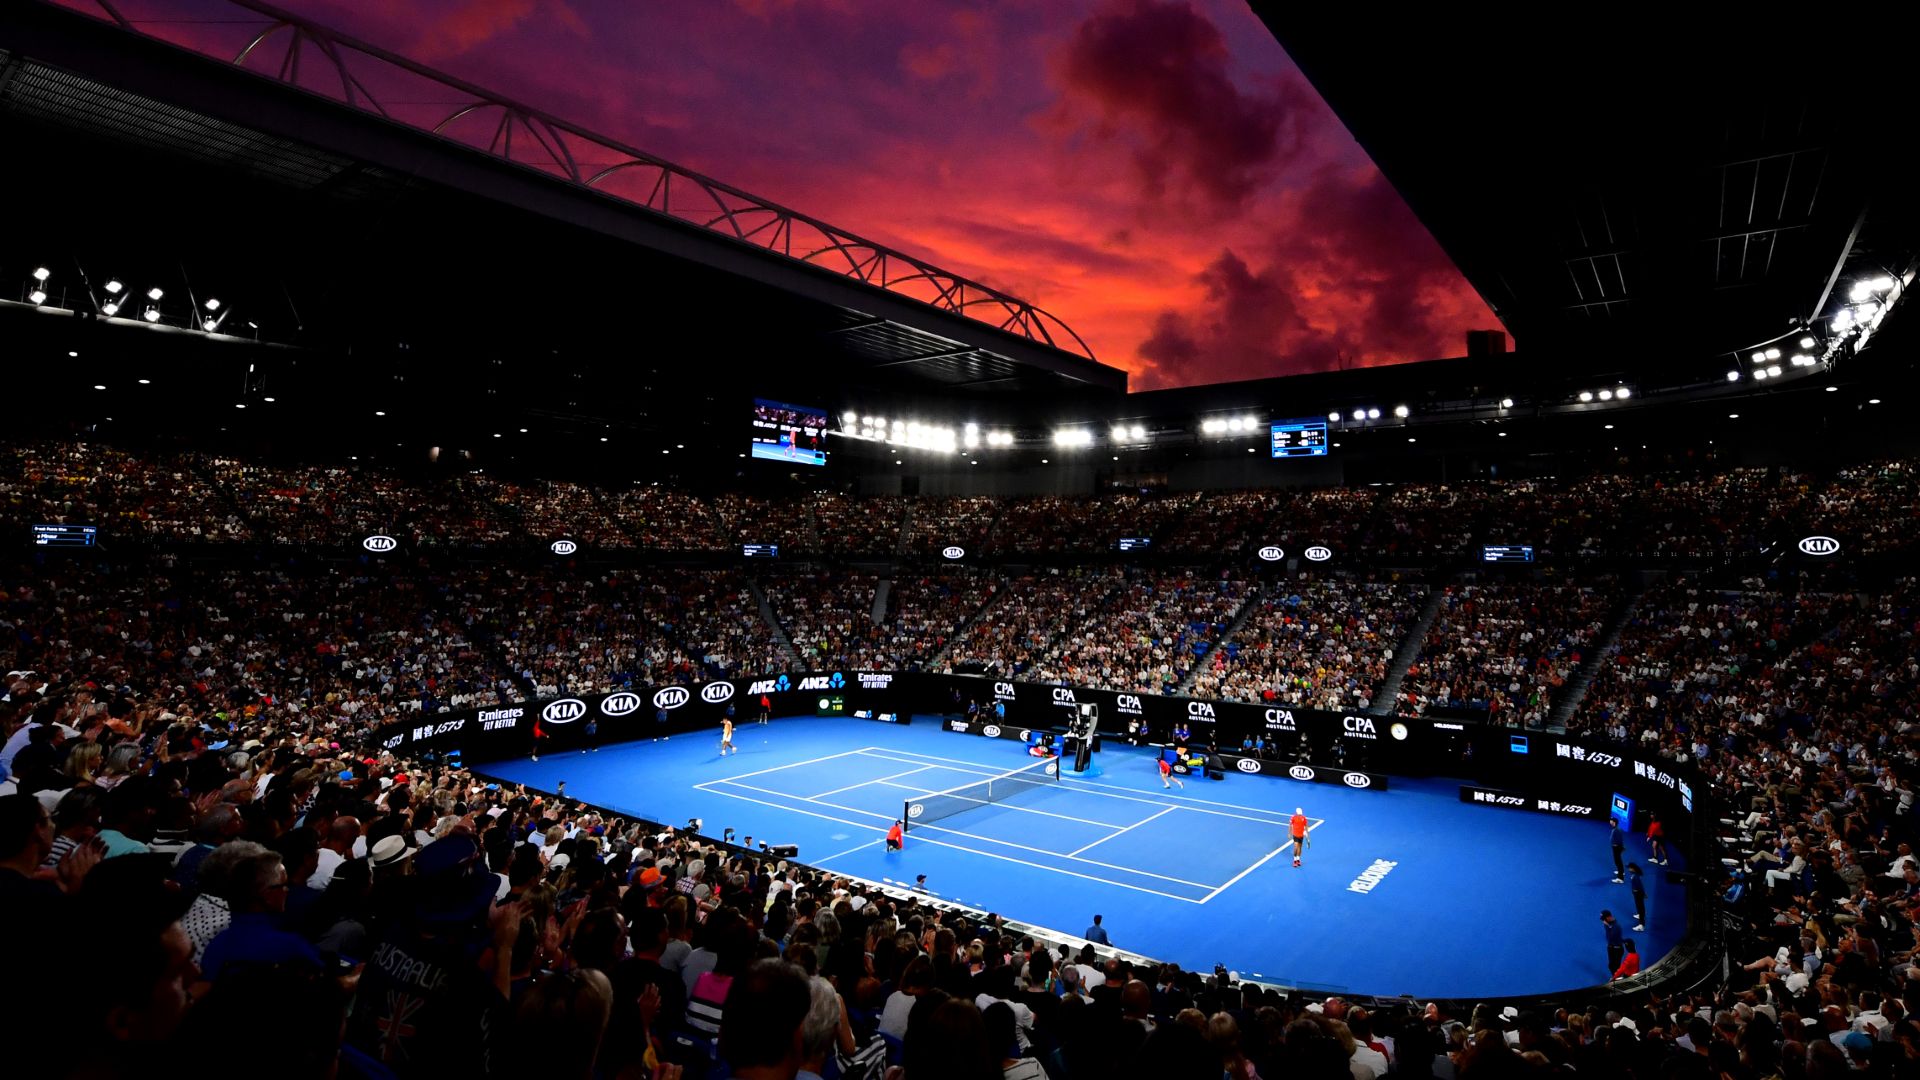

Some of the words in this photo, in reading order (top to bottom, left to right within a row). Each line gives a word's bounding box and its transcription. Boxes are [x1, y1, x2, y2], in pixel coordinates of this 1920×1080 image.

[369, 539, 391, 548] KIA
[556, 544, 572, 552] KIA
[1806, 540, 1832, 551] KIA
[1263, 550, 1280, 558] KIA
[1310, 550, 1326, 558] KIA
[798, 676, 829, 690] ANZ
[858, 673, 892, 682] Emirates
[707, 684, 728, 699] KIA
[747, 680, 776, 695] ANZ
[994, 682, 1015, 696] CPA
[660, 691, 684, 705] KIA
[1053, 688, 1076, 702] CPA
[1117, 695, 1142, 709] CPA
[550, 705, 579, 719] KIA
[608, 698, 634, 712] KIA
[1188, 702, 1215, 717] CPA
[478, 708, 524, 722] Emirates
[1265, 709, 1296, 725] CPA
[1344, 716, 1376, 734] CPA
[1344, 732, 1377, 740] AUSTRALIA
[1241, 760, 1256, 770] KIA
[1294, 766, 1310, 778] KIA
[1348, 774, 1366, 785] KIA
